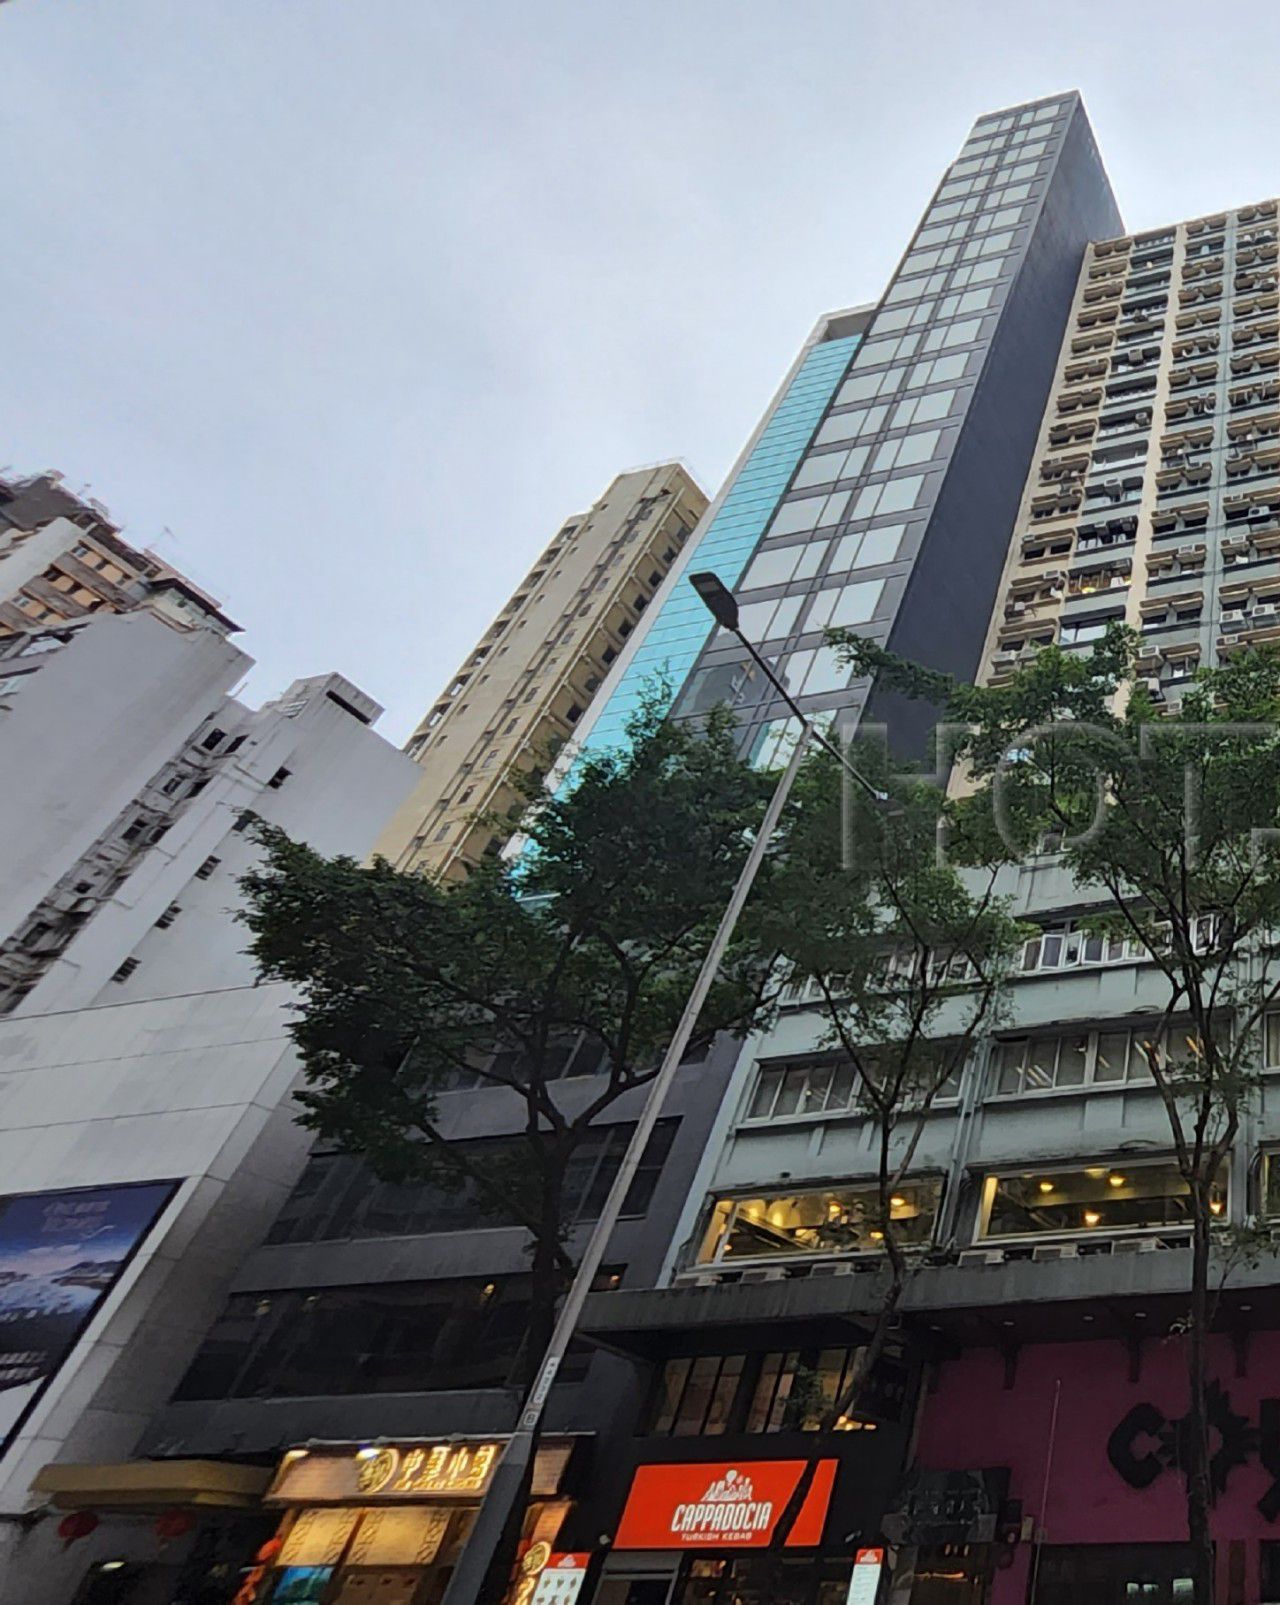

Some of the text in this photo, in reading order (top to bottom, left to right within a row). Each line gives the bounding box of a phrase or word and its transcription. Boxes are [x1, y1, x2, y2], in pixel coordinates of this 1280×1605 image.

[670, 1502, 773, 1532] CAPPADOCIA
[681, 1531, 753, 1542] TURKISH KEBAB
